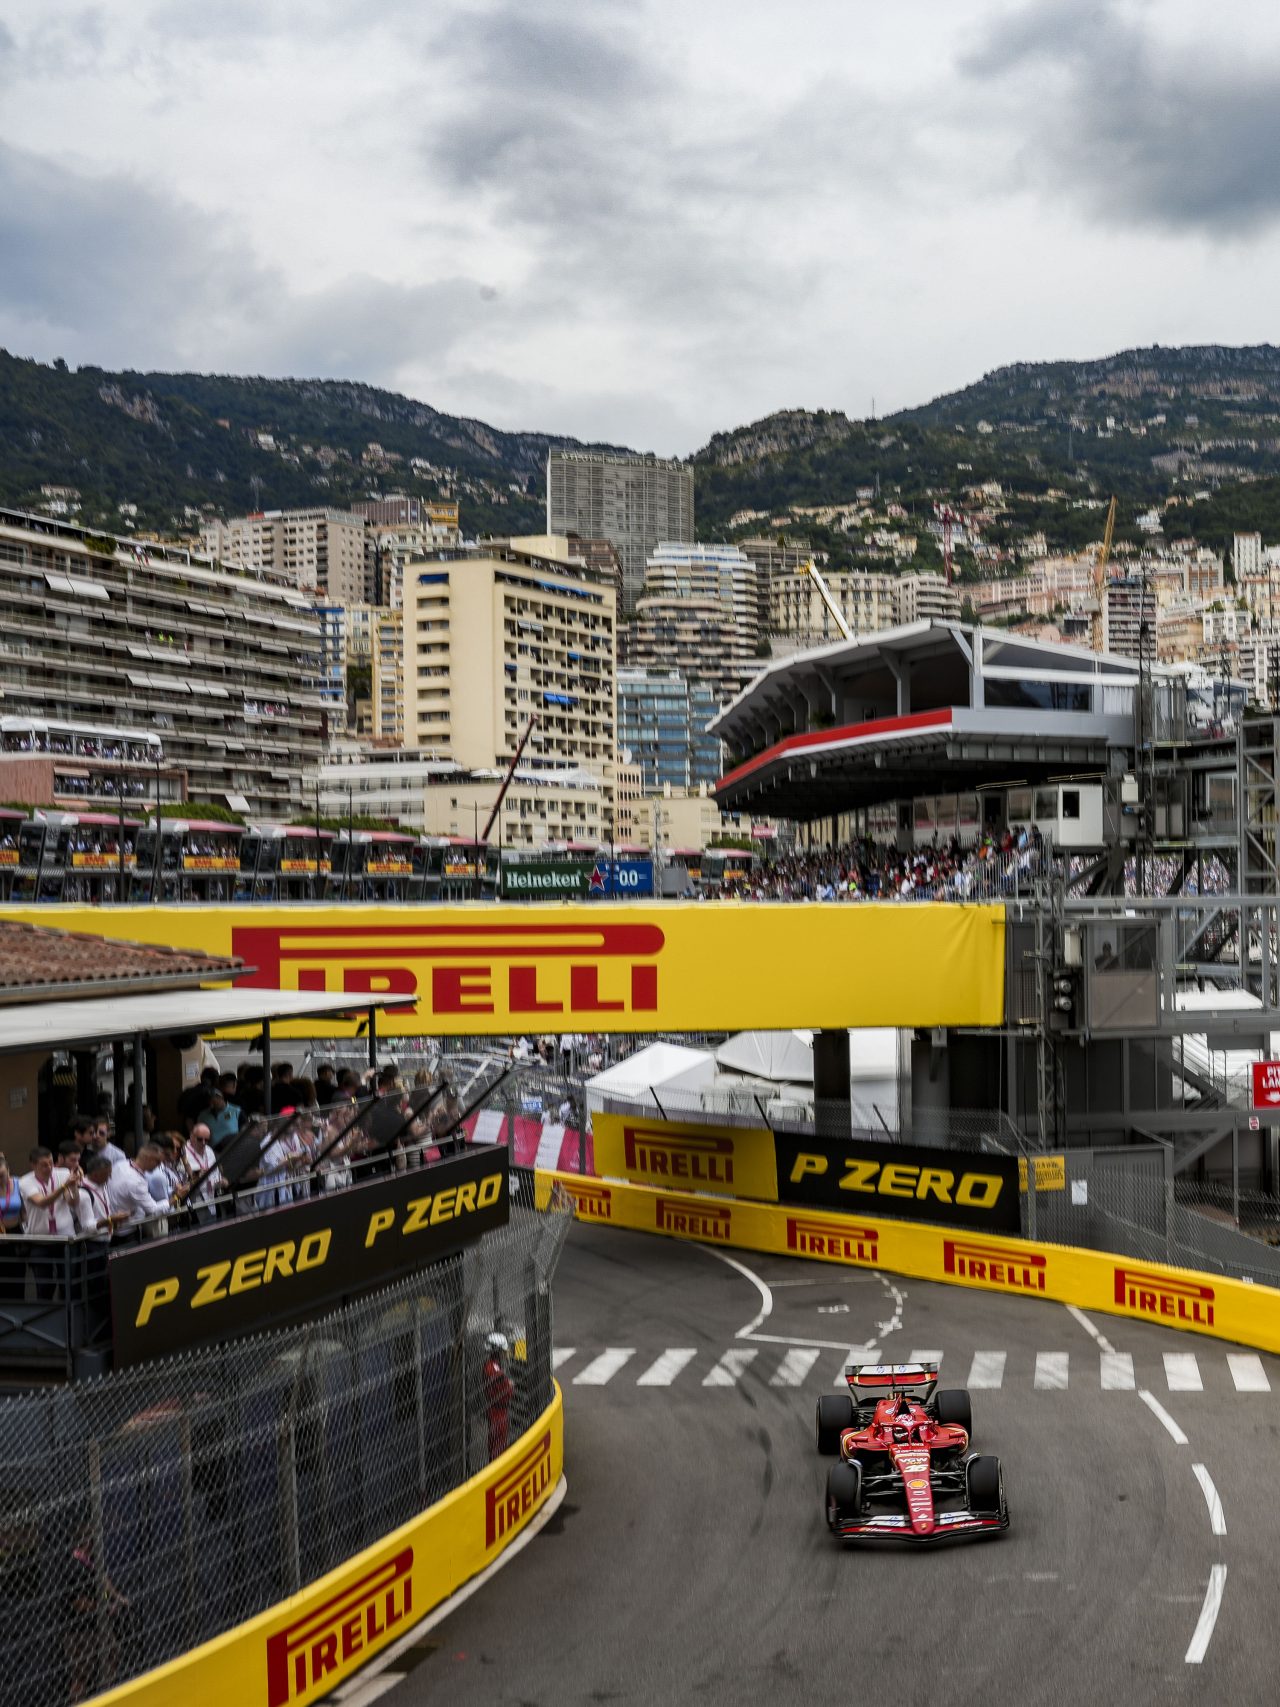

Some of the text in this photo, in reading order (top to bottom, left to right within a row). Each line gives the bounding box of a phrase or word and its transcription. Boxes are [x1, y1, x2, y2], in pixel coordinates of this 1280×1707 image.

[624, 1126, 734, 1184] PIRELLI
[790, 1152, 828, 1183] P
[839, 1158, 1003, 1209] ZERO
[365, 1207, 395, 1248] P
[402, 1173, 502, 1235] ZERO
[656, 1197, 731, 1240] PIRELLI
[787, 1217, 879, 1262] PIRELLI
[135, 1228, 332, 1328] P ZERO
[944, 1240, 1047, 1292] PIRELLI
[1115, 1267, 1215, 1327] PIRELLI
[485, 1431, 551, 1551] PIRELLI
[267, 1545, 414, 1707] PIRELLI
